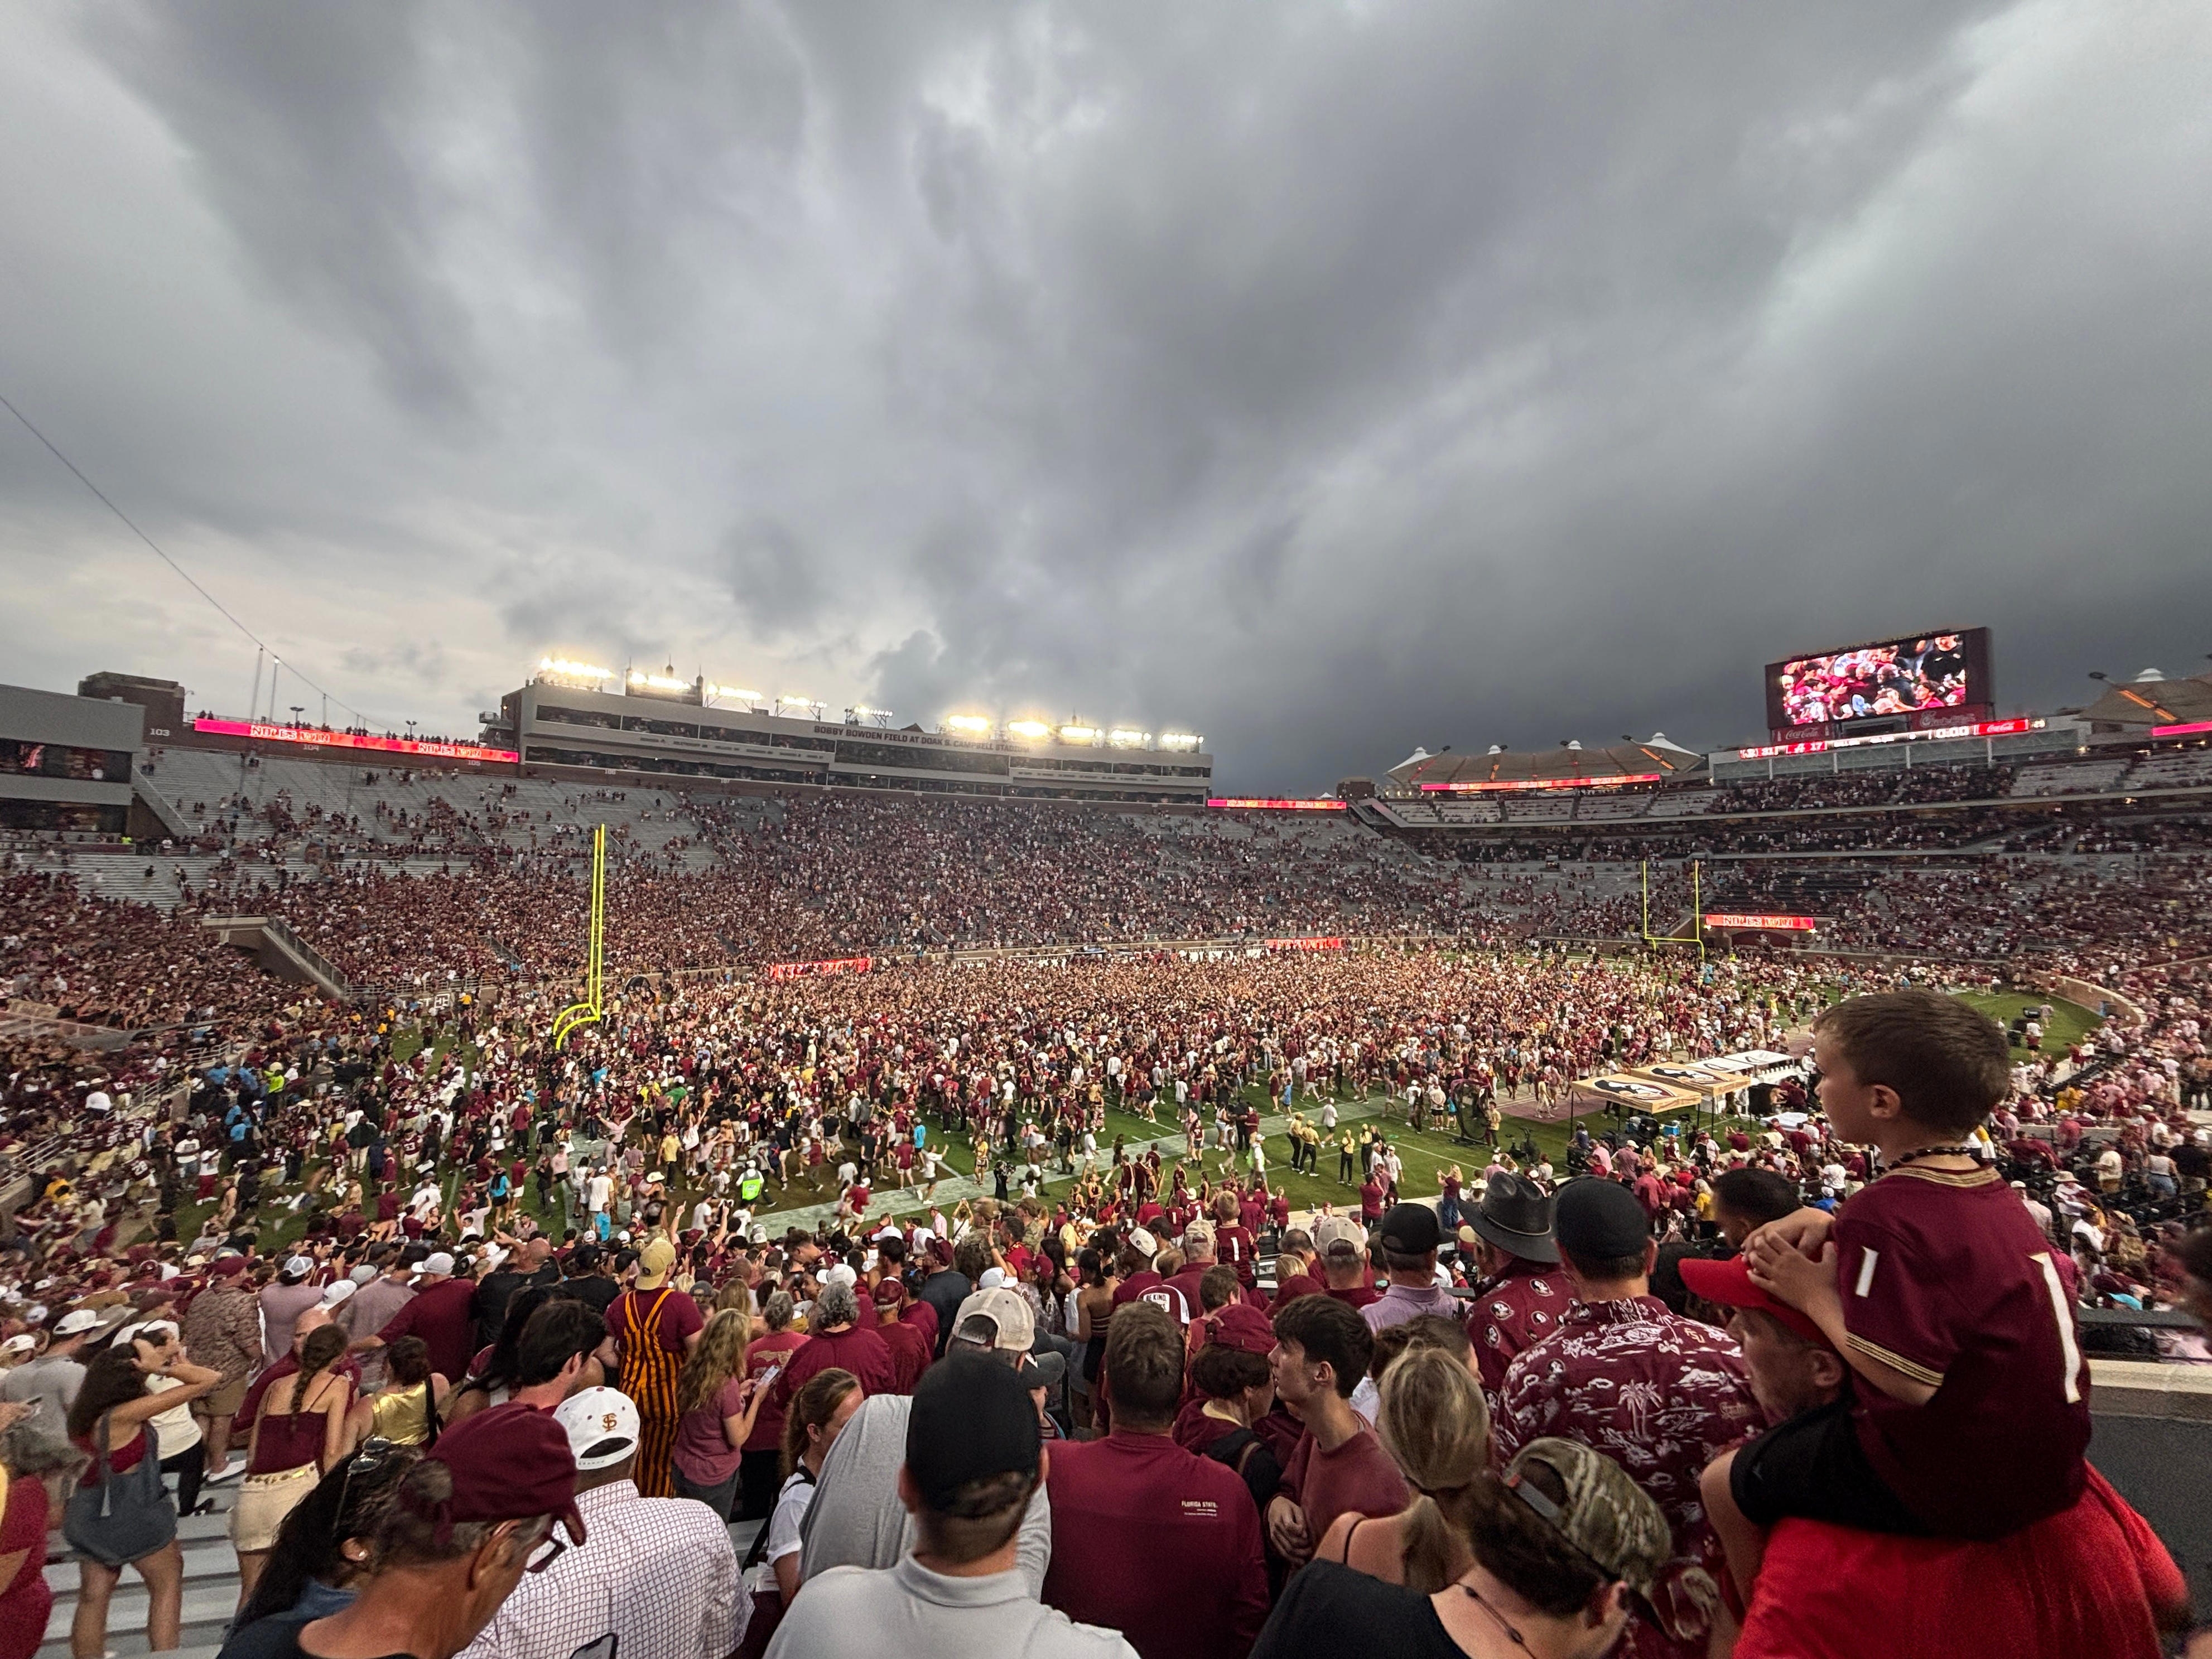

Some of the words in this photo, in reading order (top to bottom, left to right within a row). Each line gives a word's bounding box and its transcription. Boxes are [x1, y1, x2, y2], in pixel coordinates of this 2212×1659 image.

[150, 727, 170, 736] 103
[250, 725, 297, 740] NOLES
[299, 731, 330, 743] WIN
[814, 726, 844, 736] BOBBY
[846, 729, 882, 740] BOWDEN
[884, 733, 908, 742] FIELD
[921, 736, 942, 745] DOAK
[953, 740, 994, 750] CAMPBELL
[1936, 726, 1970, 739] 0:00
[1810, 742, 1823, 751] 17
[1723, 915, 1762, 927] NOLES
[1172, 1212, 1177, 1224] 1
[1231, 1237, 1240, 1261] 1
[1855, 1245, 1880, 1298] 1
[2026, 1251, 2082, 1404] 1
[1684, 1328, 1705, 1344] FSU
